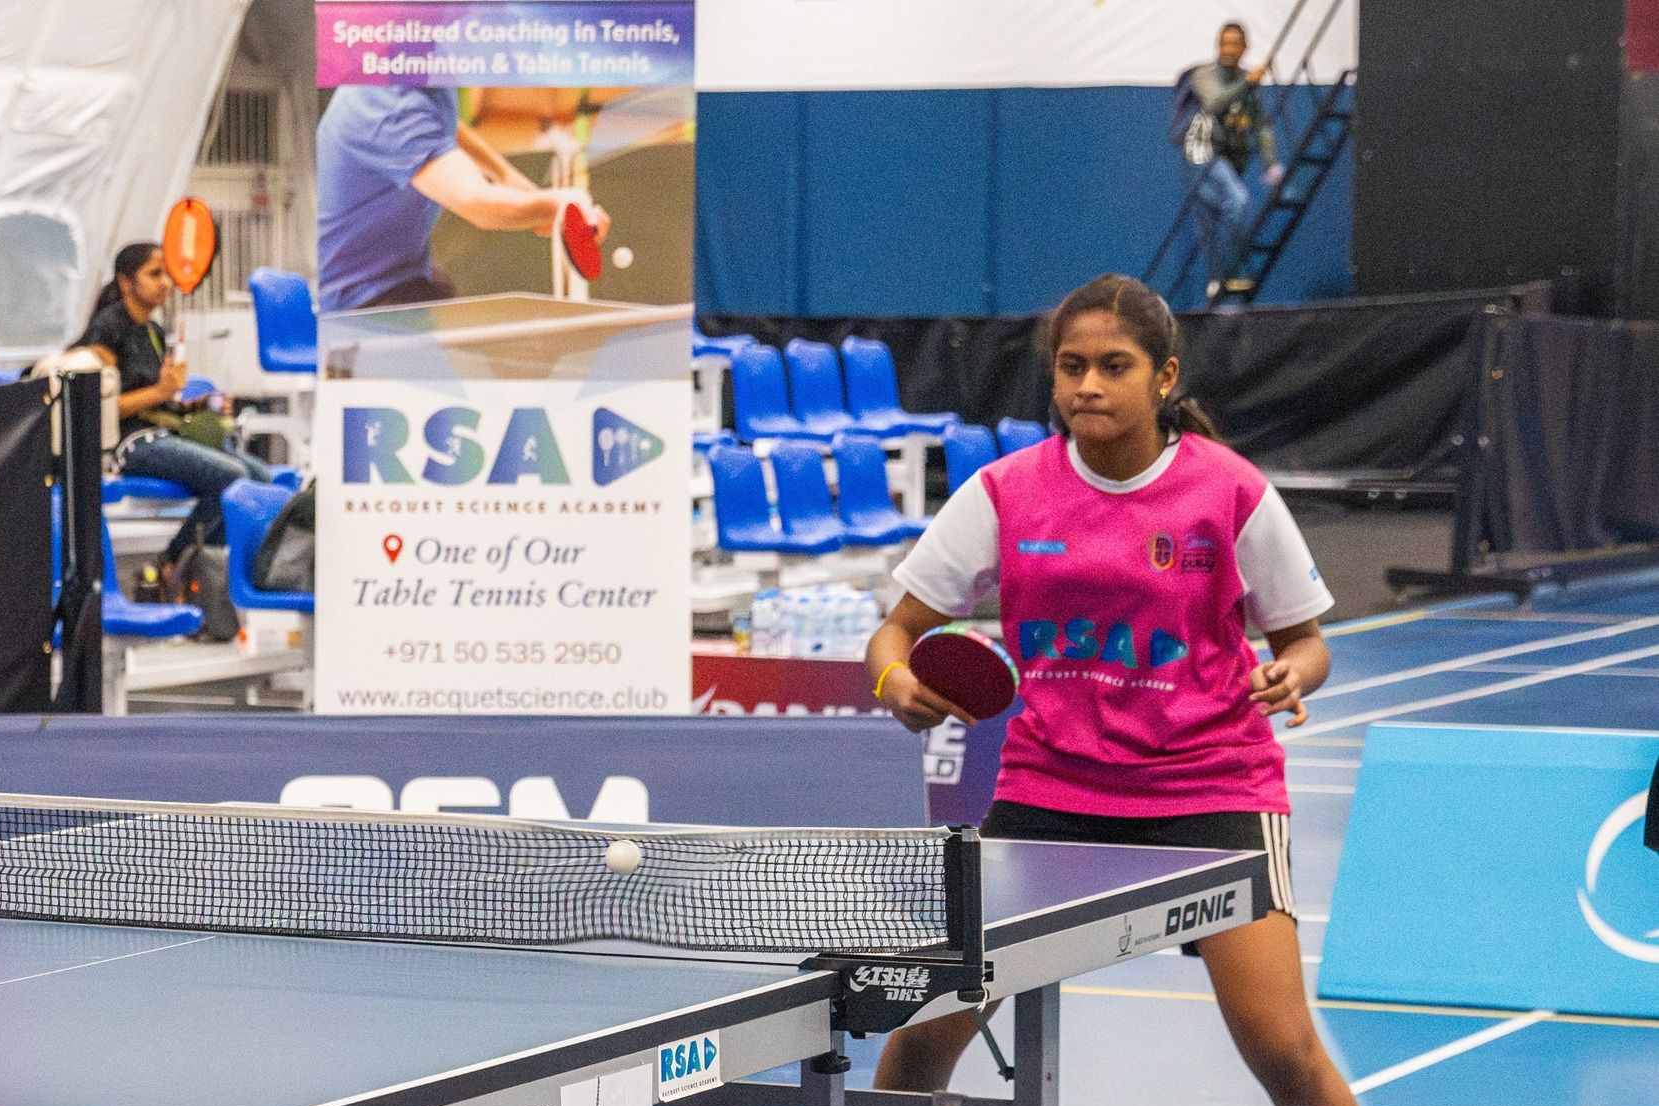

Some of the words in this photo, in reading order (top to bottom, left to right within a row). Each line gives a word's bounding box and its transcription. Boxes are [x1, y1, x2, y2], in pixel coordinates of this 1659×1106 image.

[332, 20, 461, 47] Specialized
[464, 20, 569, 47] Coaching
[573, 20, 596, 43] in
[599, 19, 680, 44] Tennis,
[362, 51, 486, 76] Badminton
[491, 53, 509, 75] &
[515, 51, 573, 75] Table
[578, 51, 651, 75] Tennis
[342, 406, 572, 486] RSA
[344, 500, 444, 514] RACQUET
[455, 500, 547, 514] SCIENCE
[559, 500, 664, 514] ACADEMY
[414, 536, 476, 565] One
[486, 534, 520, 573] of
[524, 536, 586, 565] Our
[354, 578, 437, 608] Table
[449, 578, 547, 608] Tennis
[557, 581, 658, 609] Center
[383, 641, 444, 664] +971
[454, 641, 488, 664] 50
[495, 641, 545, 664] 535
[554, 641, 622, 665] 2950
[337, 685, 668, 713] www.racquetscience.club
[1164, 890, 1237, 936] DONIC
[884, 988, 929, 1002] DHS
[661, 1040, 702, 1083] RSA
